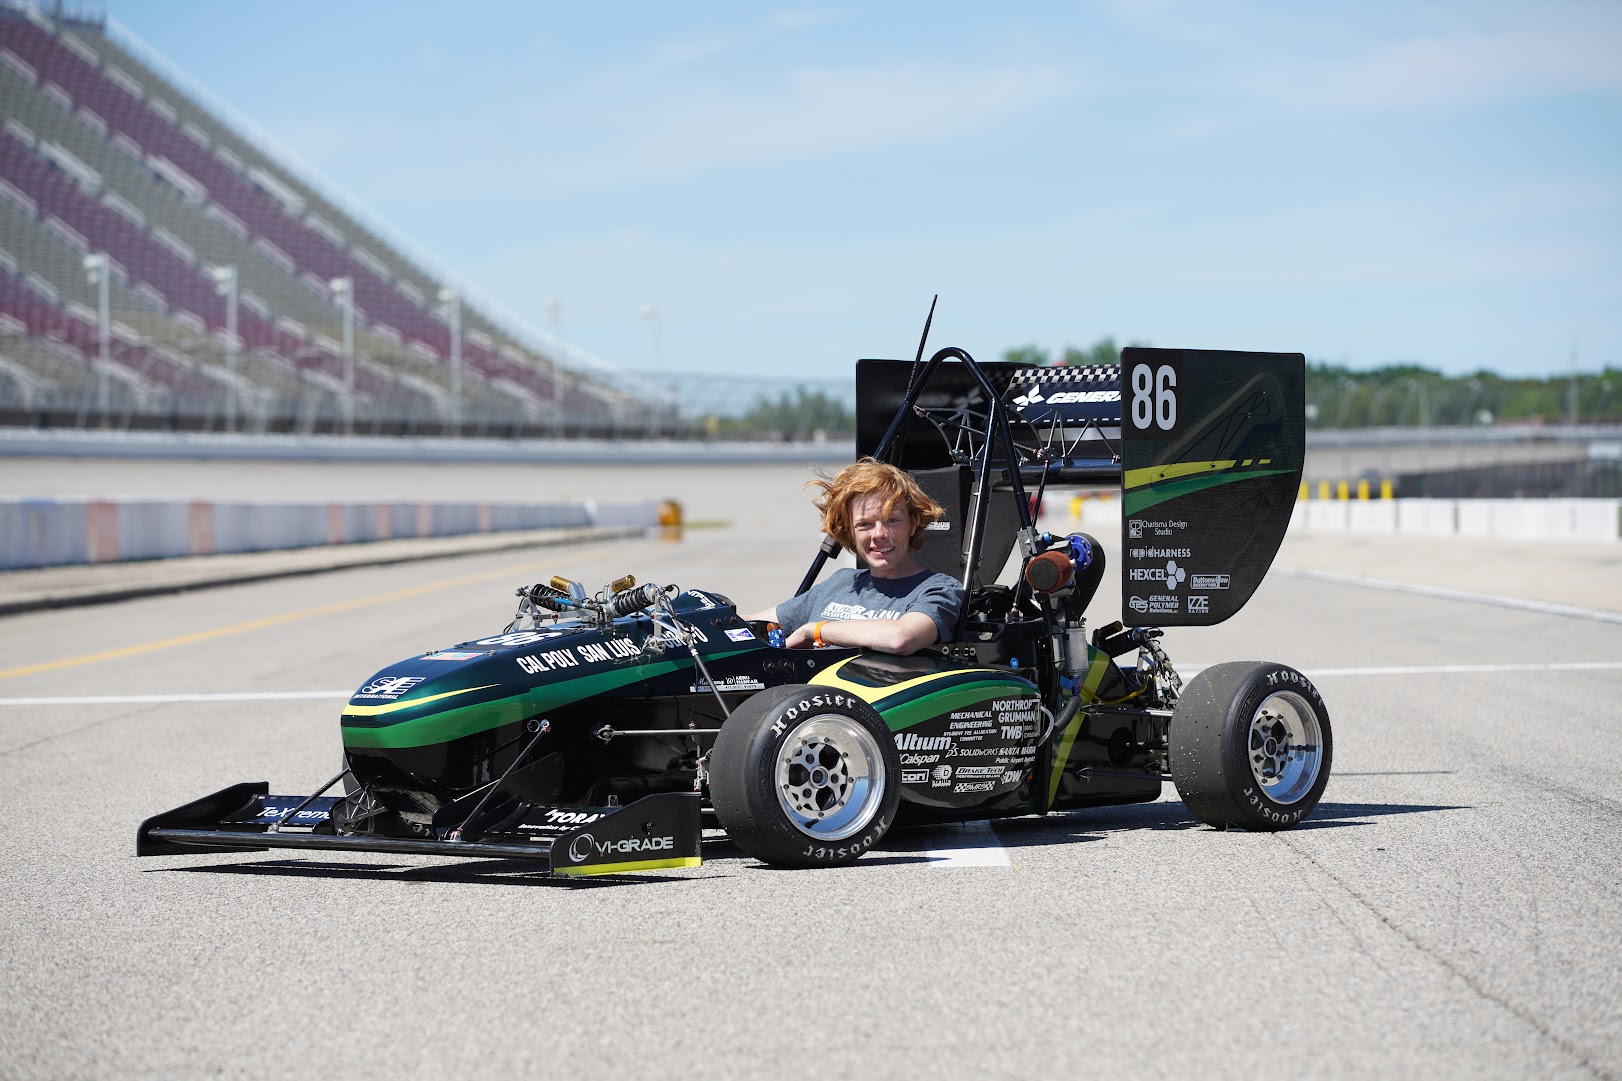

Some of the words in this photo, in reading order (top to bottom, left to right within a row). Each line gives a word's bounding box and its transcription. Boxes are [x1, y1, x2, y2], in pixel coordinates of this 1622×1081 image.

[1131, 363, 1177, 431] 86
[1142, 520, 1167, 528] Charisma
[1169, 520, 1188, 529] Design
[1154, 528, 1173, 536] Studio
[1129, 569, 1167, 581] HEXCEL
[516, 655, 550, 675] CAL
[540, 648, 579, 670] POLY
[576, 643, 612, 663] SAN
[604, 638, 641, 658] LUIS
[1267, 670, 1324, 707] Hoosier
[992, 699, 1033, 712] NORTHROP
[770, 693, 856, 738] Hoosier
[950, 710, 992, 719] MECHANICAL
[998, 711, 1036, 723] GRUMMAN
[949, 720, 993, 730] ENGINEERING
[1000, 725, 1022, 740] TWB
[893, 733, 951, 750] Altium
[998, 747, 1020, 756] SANTA
[899, 753, 940, 766] Calspan
[1243, 787, 1305, 824] Hoosier
[802, 815, 888, 860] Hoosier
[595, 836, 674, 854] VI-GRADE
